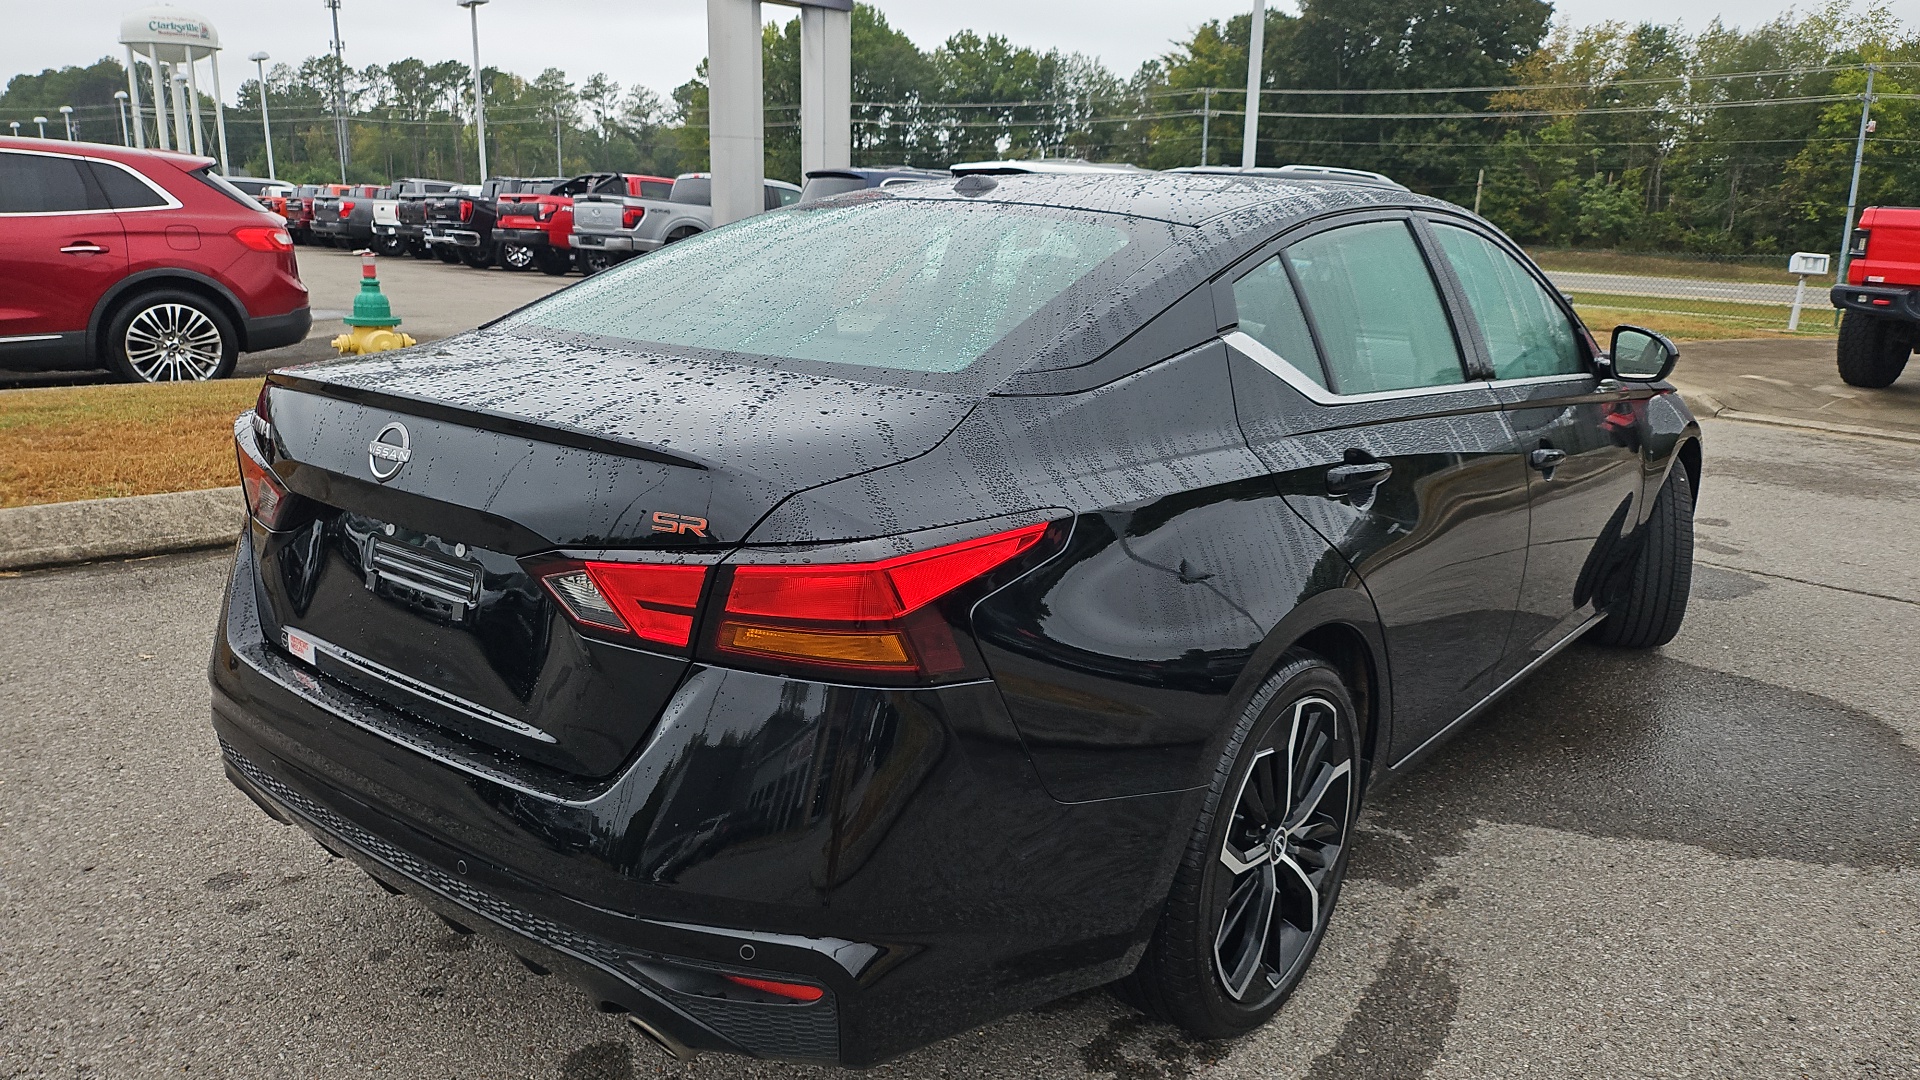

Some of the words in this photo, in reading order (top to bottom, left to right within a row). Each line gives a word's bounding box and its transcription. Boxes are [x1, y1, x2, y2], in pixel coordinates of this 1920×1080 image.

[148, 20, 199, 33] Clarksville
[369, 442, 410, 461] NISSAN
[651, 511, 708, 538] SR
